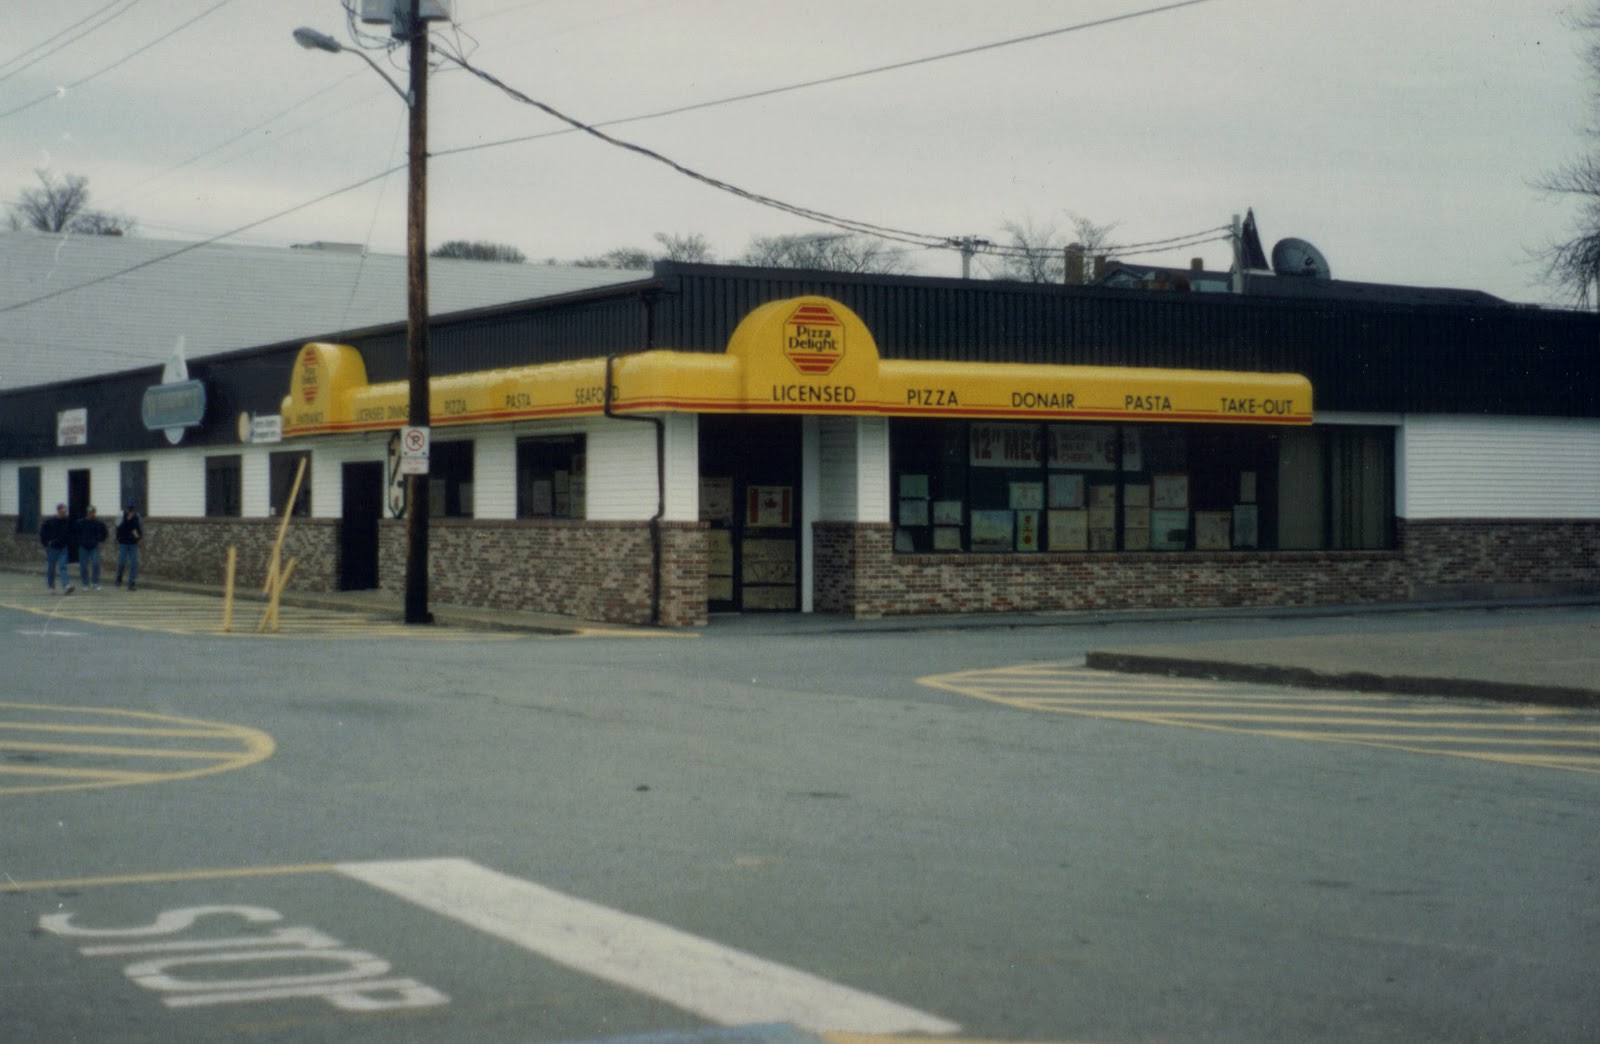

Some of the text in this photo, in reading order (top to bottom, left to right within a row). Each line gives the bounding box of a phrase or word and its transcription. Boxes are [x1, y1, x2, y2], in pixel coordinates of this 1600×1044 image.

[796, 325, 831, 339] Pizza
[788, 336, 837, 352] Delight
[506, 393, 531, 408] PASTA
[575, 386, 620, 405] SEAFOD
[772, 385, 856, 403] LICENSED
[907, 389, 959, 407] PIZZA
[1011, 391, 1075, 409] DONAIR
[444, 400, 467, 415] PIZZA
[1125, 395, 1172, 412] PASTA
[1221, 398, 1293, 415] TAKE-OUT
[37, 904, 452, 1012] STOP
